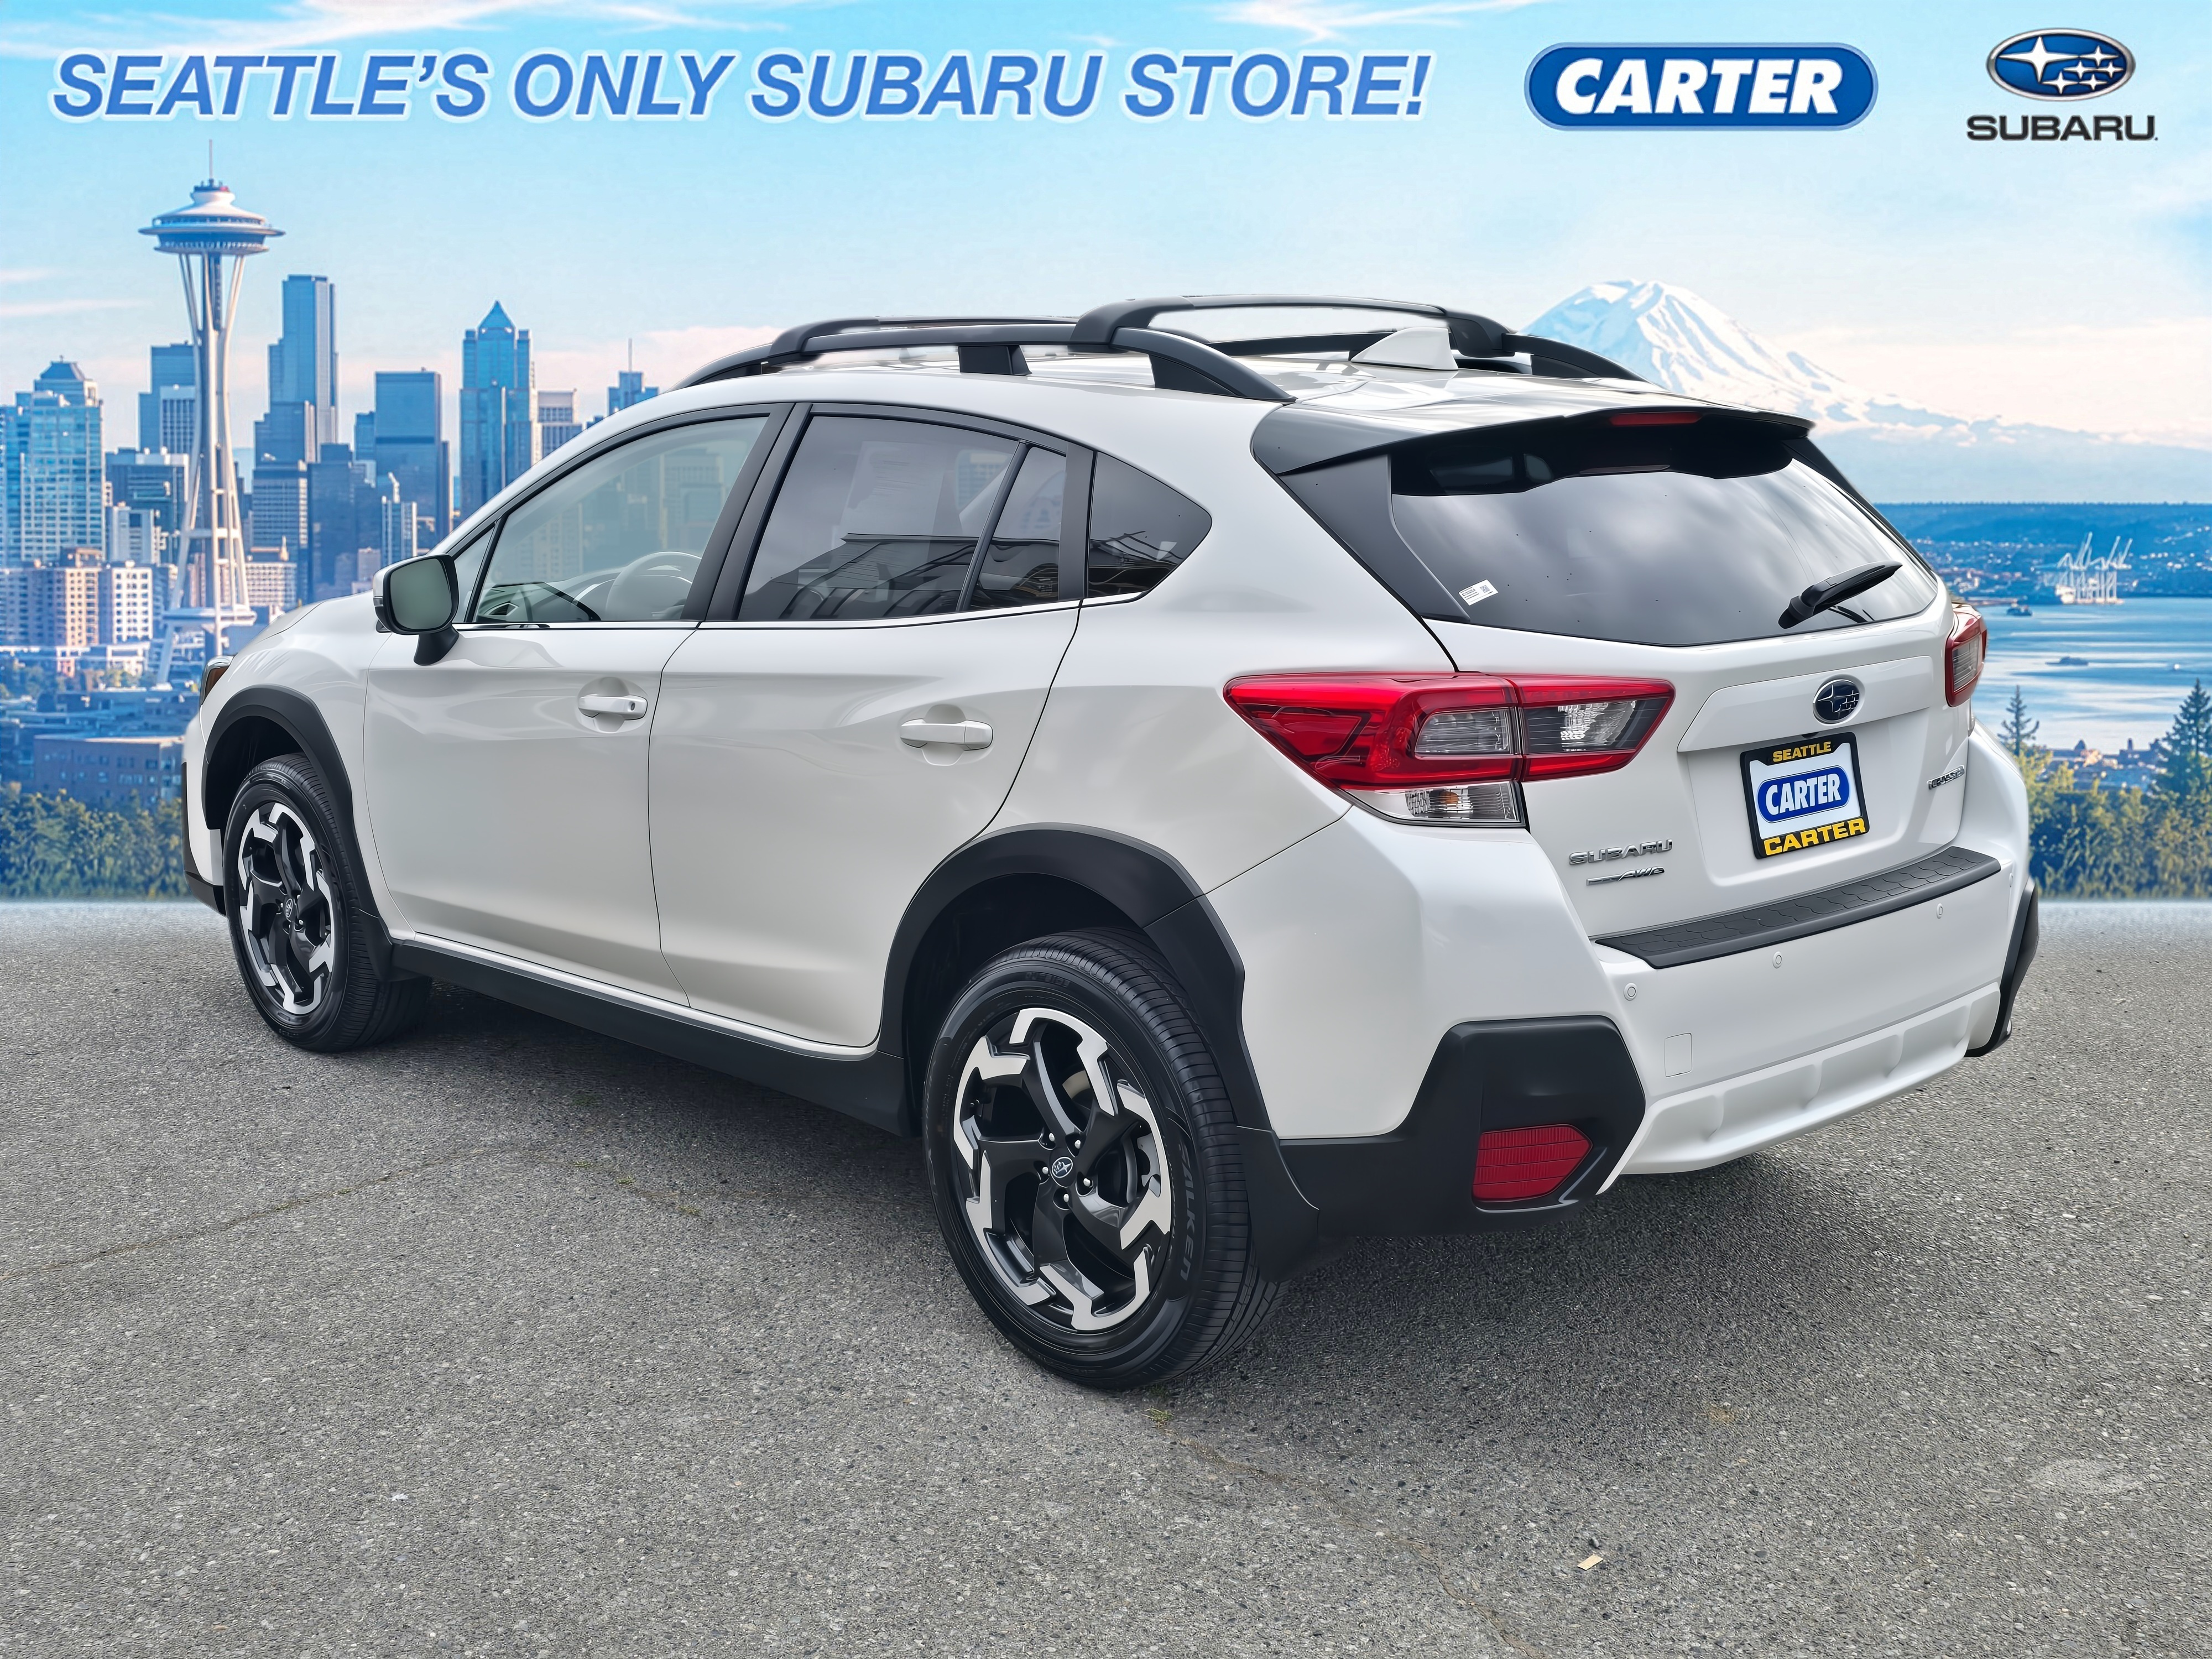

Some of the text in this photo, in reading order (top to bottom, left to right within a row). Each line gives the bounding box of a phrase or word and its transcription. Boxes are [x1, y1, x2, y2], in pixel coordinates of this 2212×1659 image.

[1773, 741, 1832, 763] SEATTLE
[1766, 773, 1841, 815] CARTER
[1569, 838, 1673, 865] SUBARU
[1764, 818, 1866, 856] CARTER
